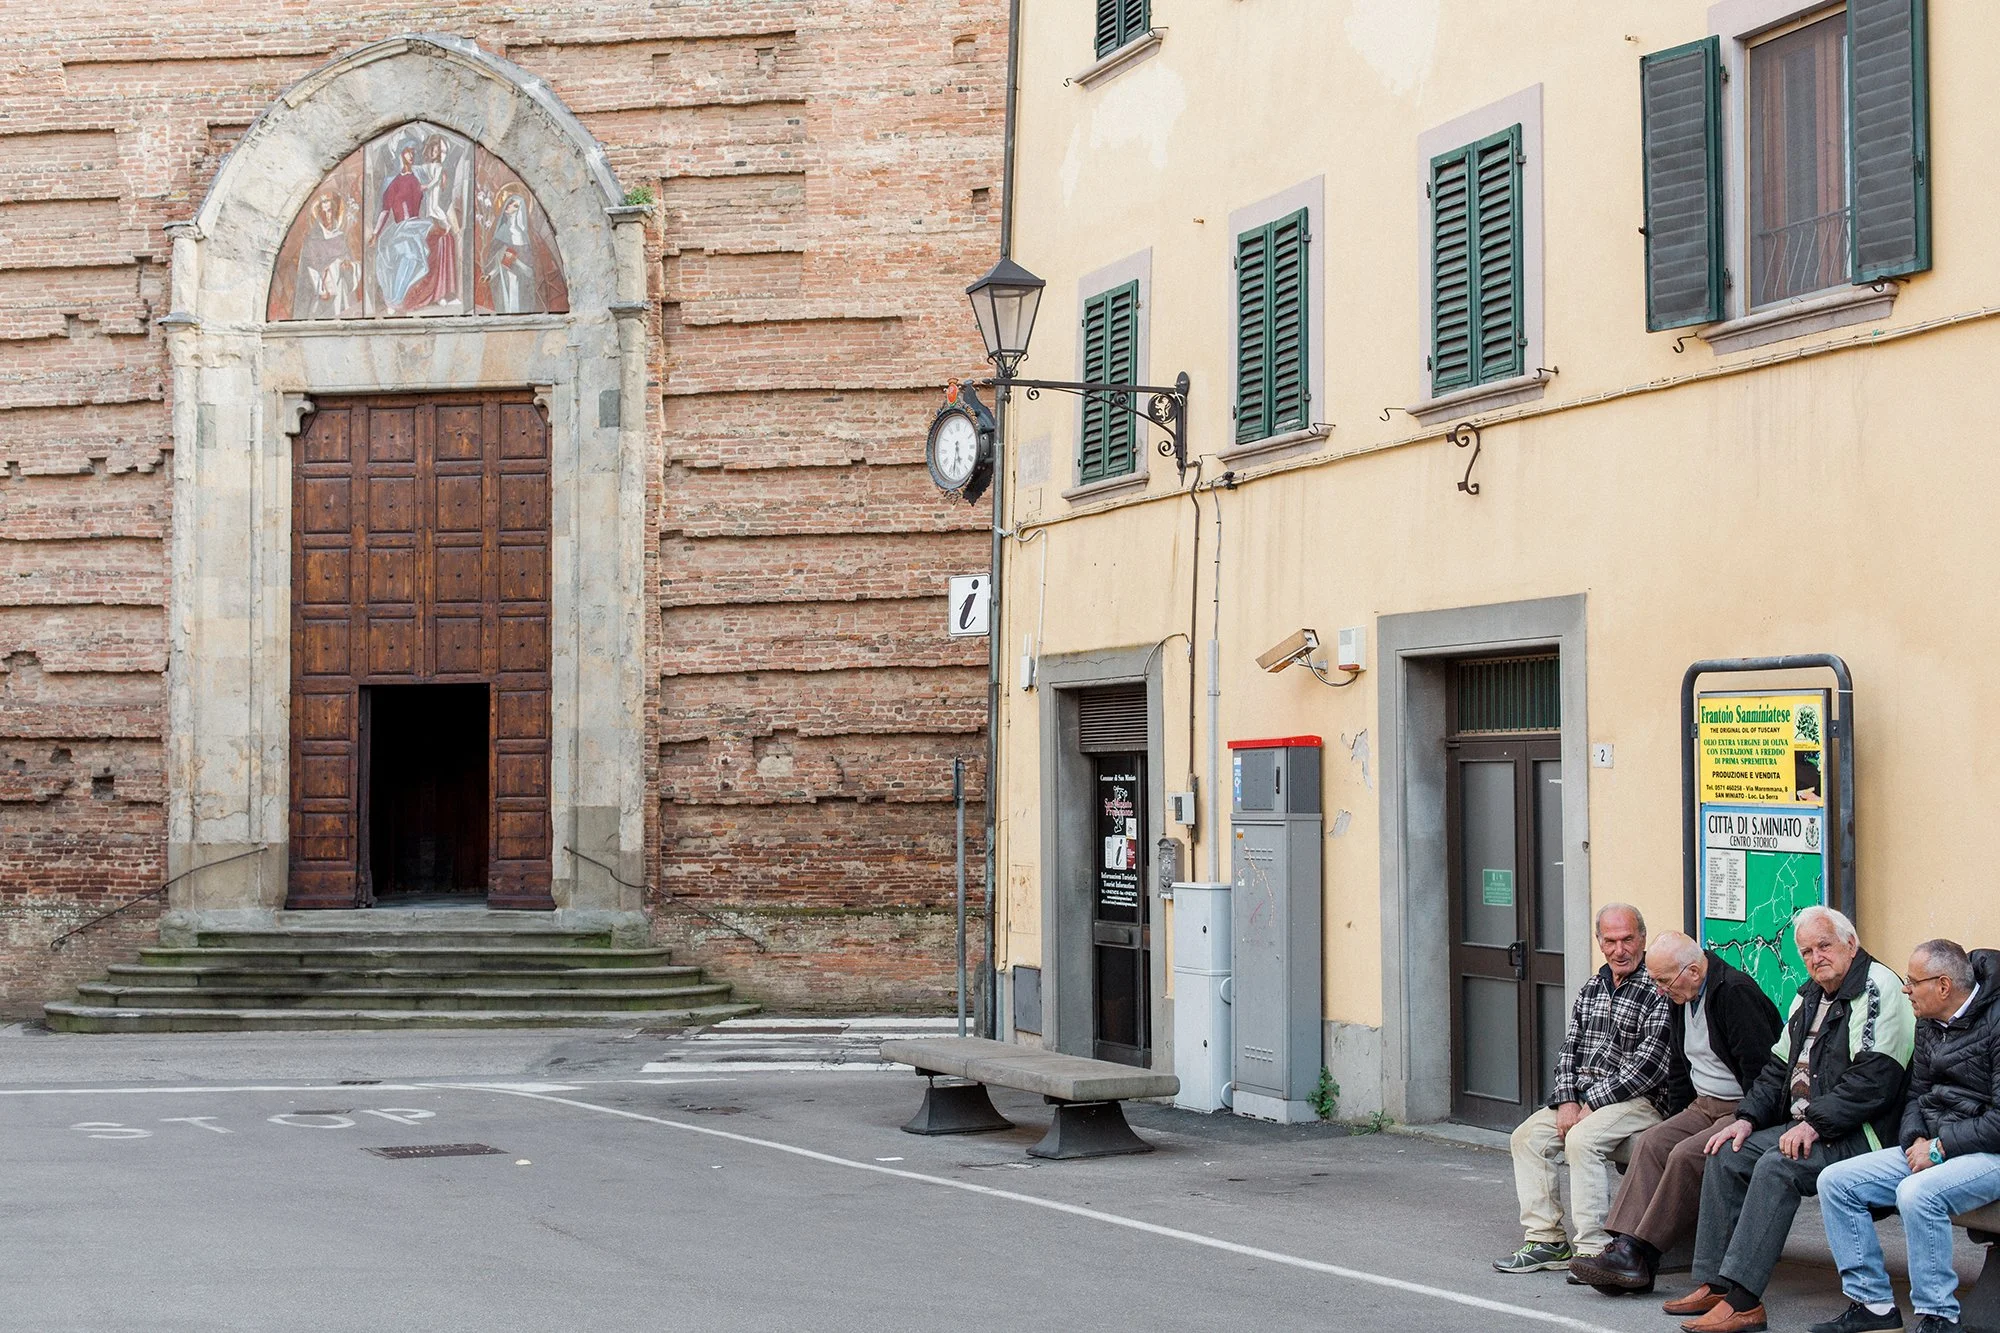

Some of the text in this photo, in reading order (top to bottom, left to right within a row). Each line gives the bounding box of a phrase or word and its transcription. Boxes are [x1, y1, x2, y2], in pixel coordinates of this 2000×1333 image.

[959, 579, 979, 630] i
[1701, 704, 1791, 723] Frantoio Sanminiatese
[1600, 749, 1605, 762] 2
[1738, 816, 1748, 835] DI
[1752, 817, 1802, 837] S.MINIATO
[1729, 835, 1778, 848] CENTRO STORICO
[70, 1108, 437, 1139] STOP
